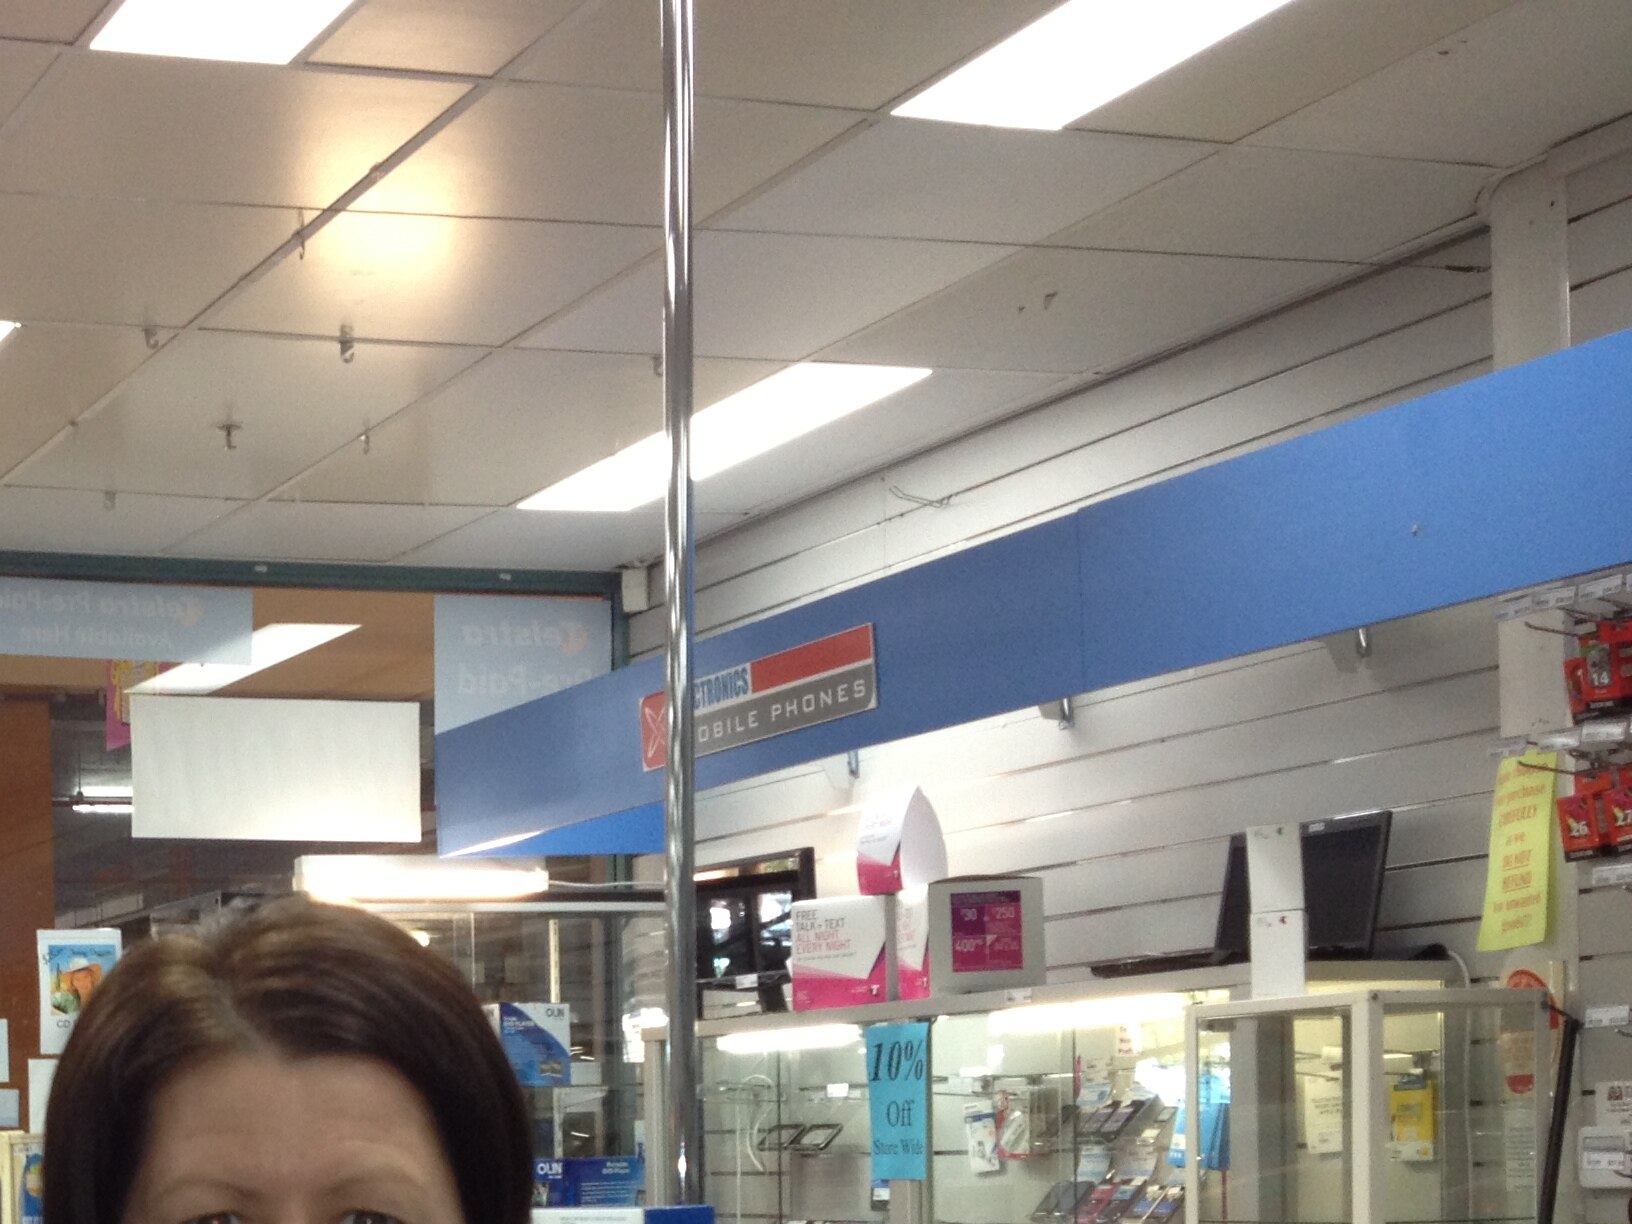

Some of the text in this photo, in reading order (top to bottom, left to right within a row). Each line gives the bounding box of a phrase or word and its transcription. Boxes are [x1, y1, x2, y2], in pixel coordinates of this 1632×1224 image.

[694, 667, 750, 710] CTRONICS
[697, 680, 867, 743] OBILE PHONES
[824, 917, 845, 929] TEXT
[870, 1039, 924, 1082] 10%
[886, 1100, 915, 1128] Off
[873, 1138, 924, 1155] Store Wide
